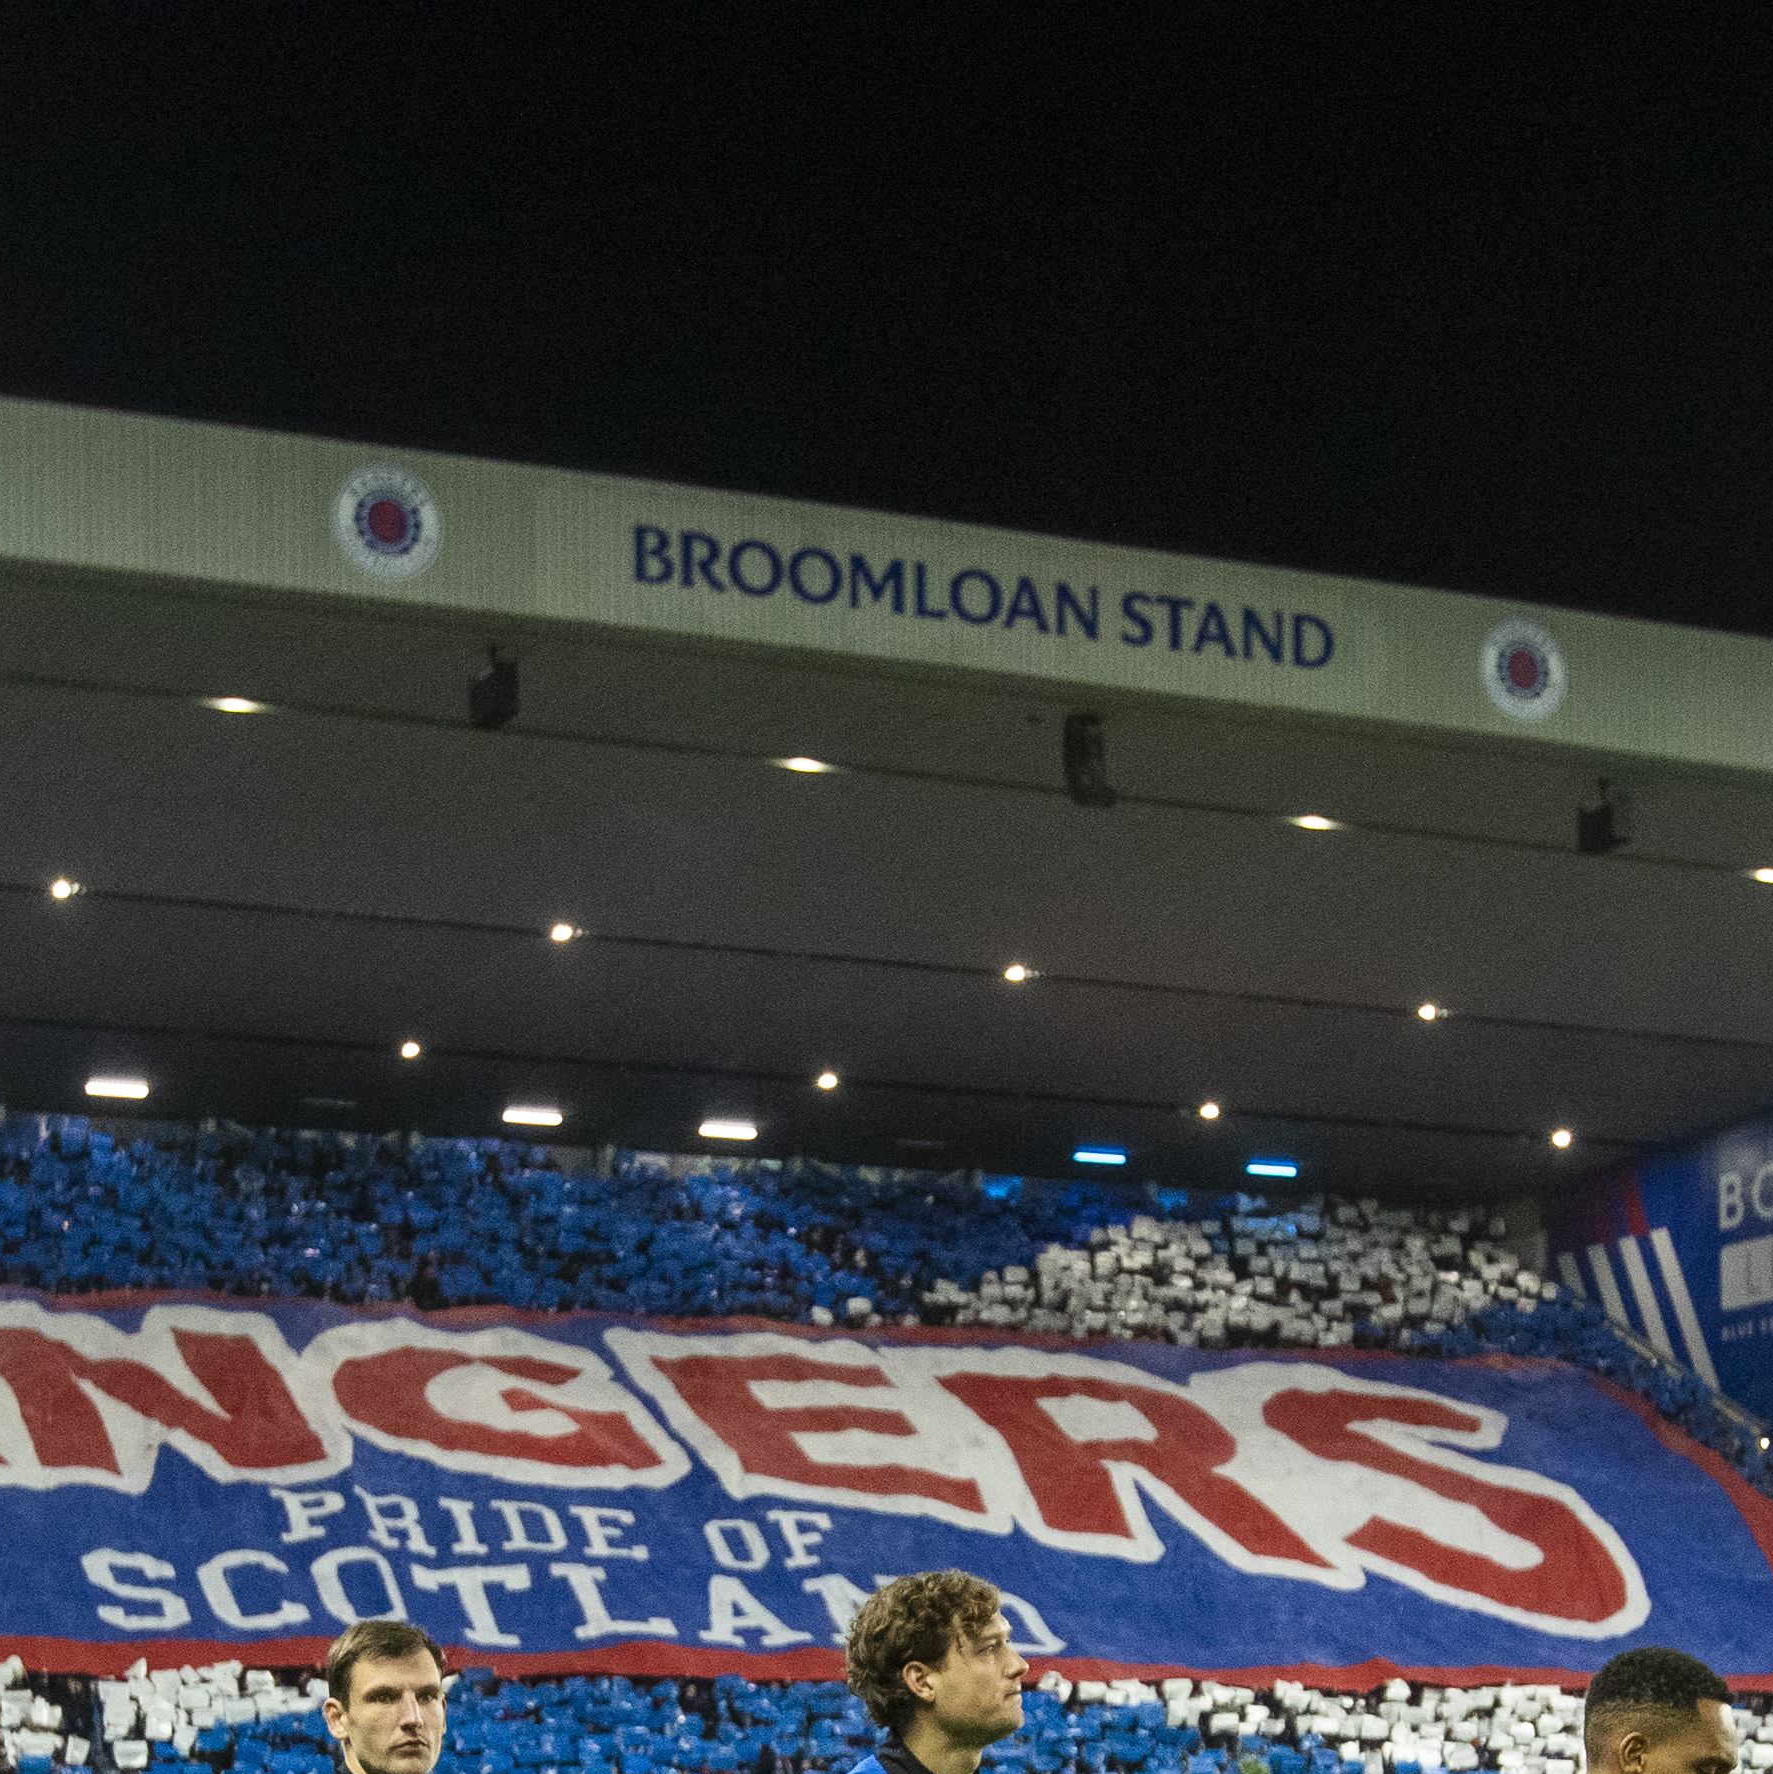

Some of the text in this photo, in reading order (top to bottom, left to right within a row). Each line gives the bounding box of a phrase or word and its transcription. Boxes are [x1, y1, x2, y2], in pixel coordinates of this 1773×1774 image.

[633, 523, 1335, 671] BROOMLOAN STAND
[272, 1486, 831, 1571] PRIDE OF
